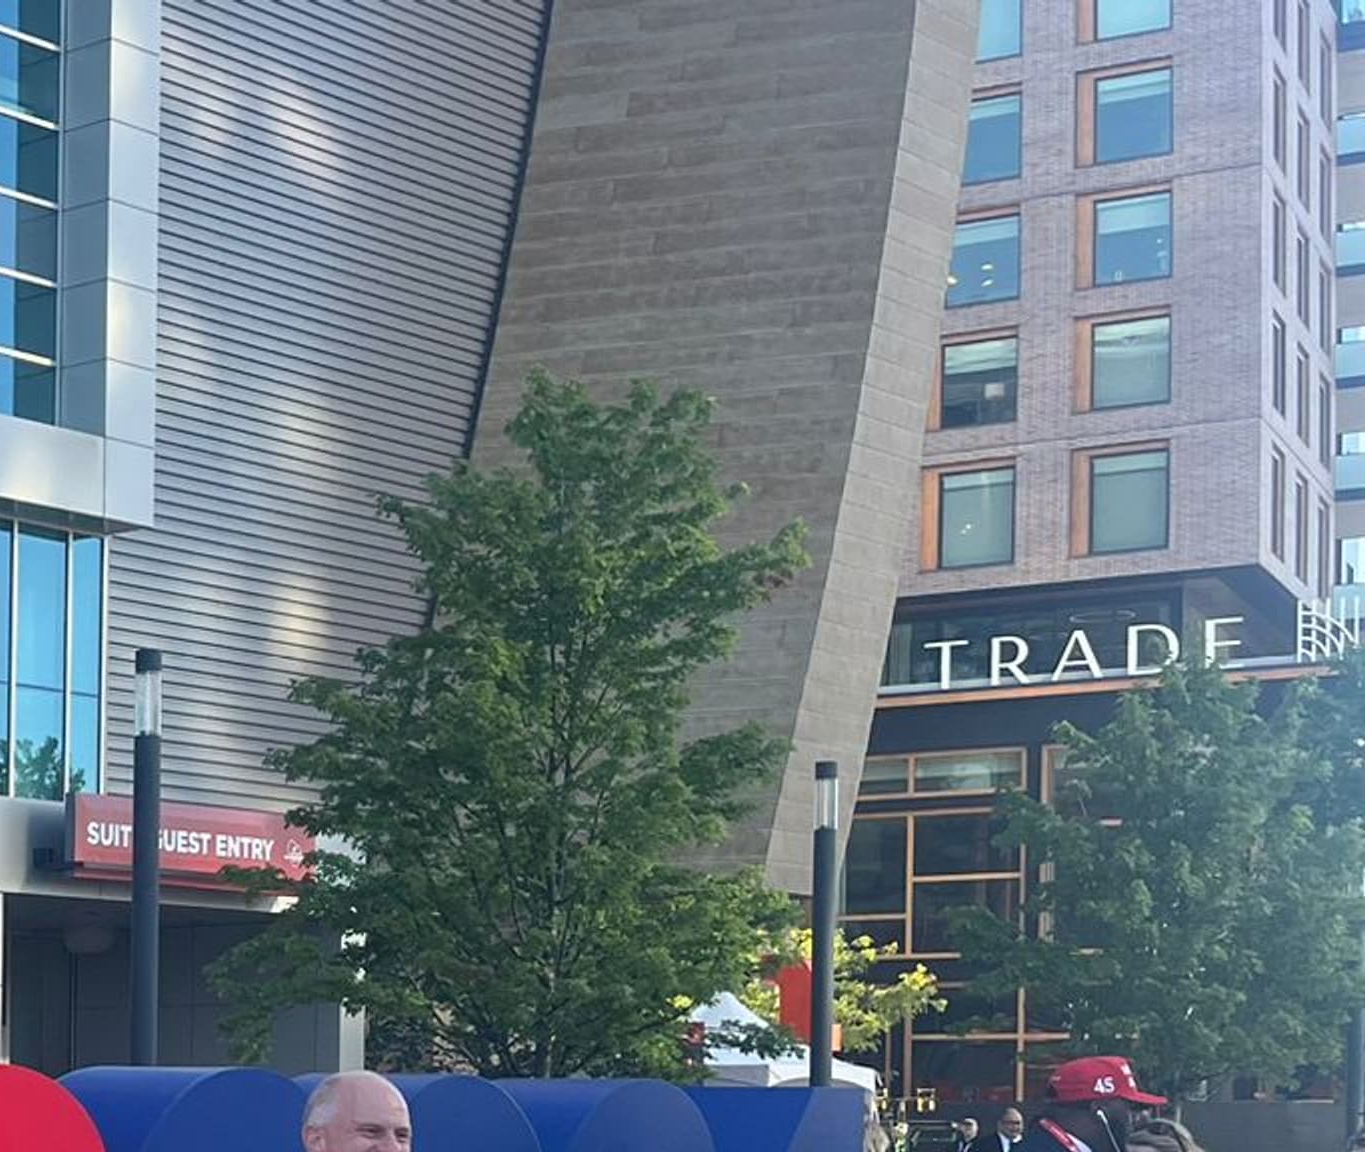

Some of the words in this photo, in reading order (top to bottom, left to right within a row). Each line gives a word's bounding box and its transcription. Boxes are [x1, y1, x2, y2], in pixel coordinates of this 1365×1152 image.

[924, 616, 1245, 690] TRADE
[87, 821, 134, 848] SUIT
[215, 834, 275, 861] ENTRY
[1094, 1076, 1116, 1093] 45
